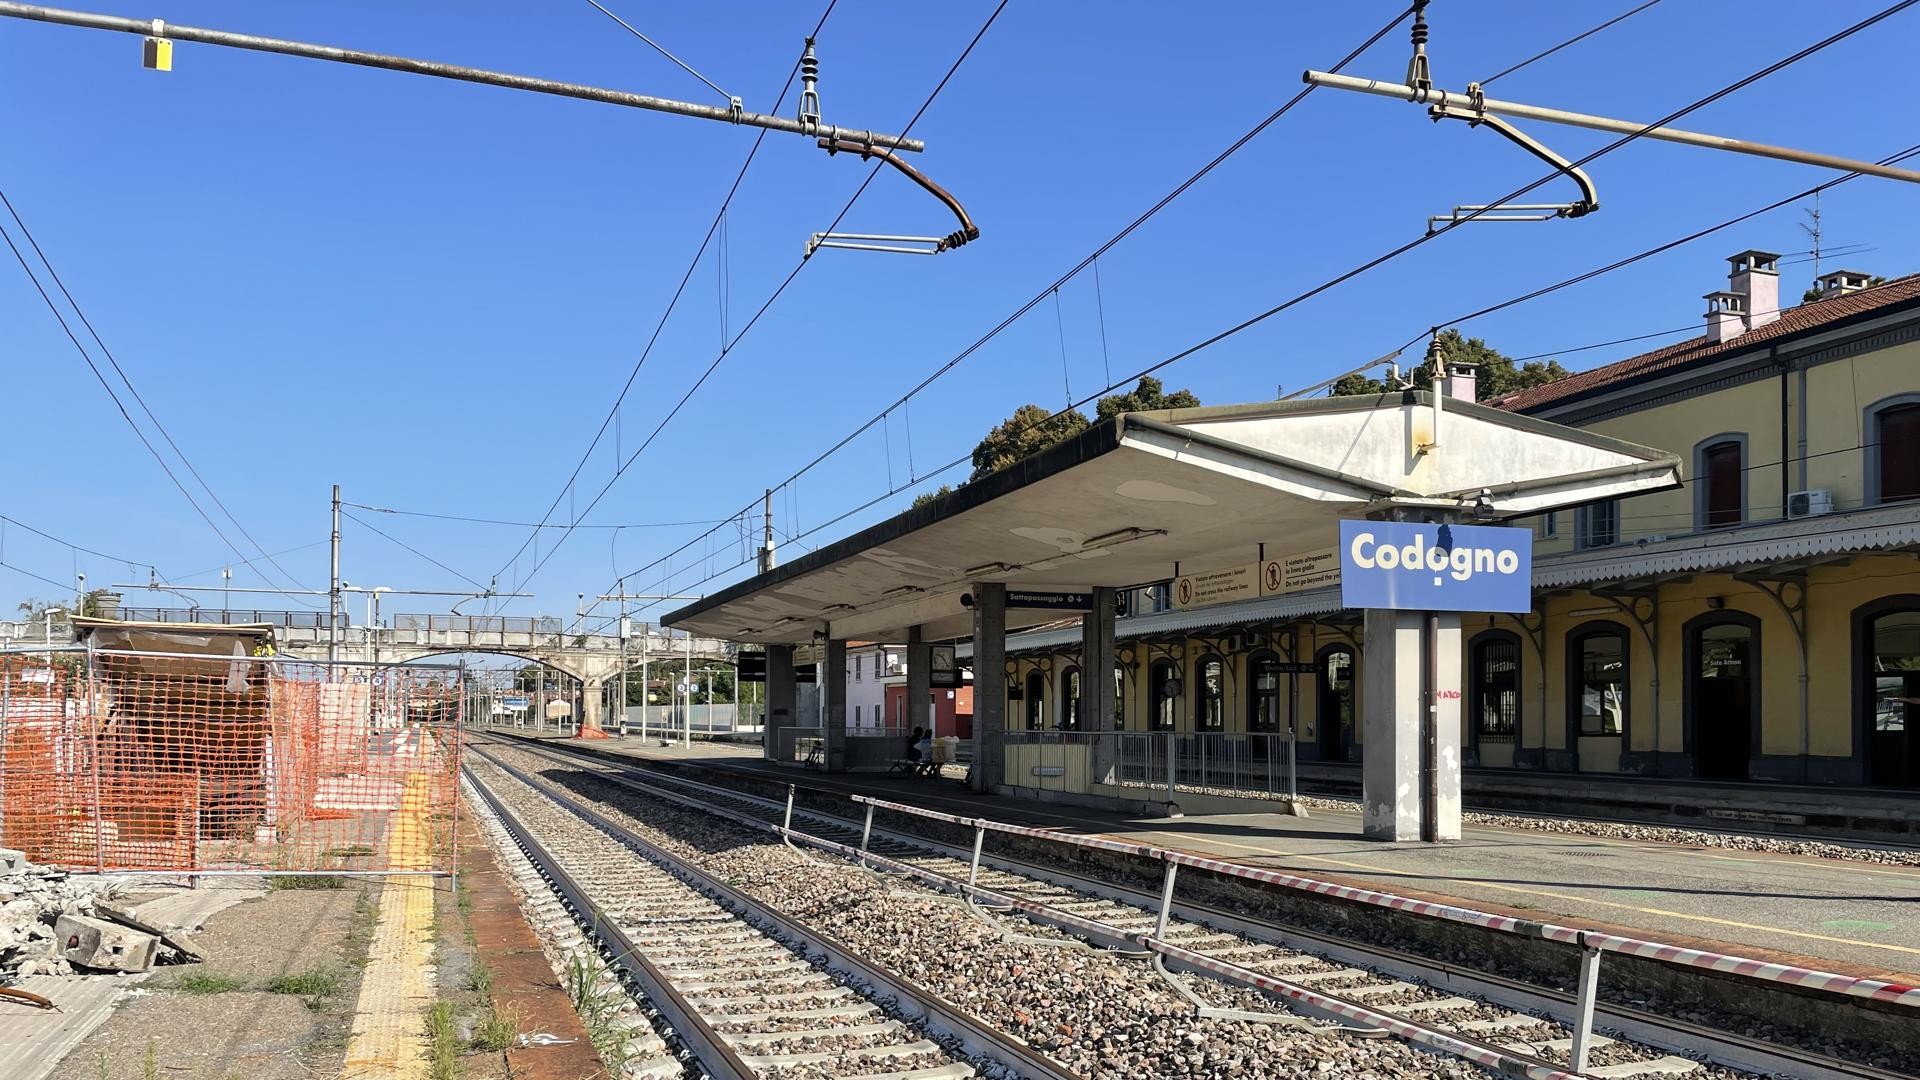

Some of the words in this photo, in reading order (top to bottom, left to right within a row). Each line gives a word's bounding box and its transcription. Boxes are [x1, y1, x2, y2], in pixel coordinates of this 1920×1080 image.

[1304, 553, 1333, 563] oltrepassare
[1351, 533, 1519, 581] Codogno
[1290, 566, 1302, 574] linea
[1300, 579, 1307, 587] go
[1306, 575, 1325, 585] beyond
[1009, 593, 1064, 603] Sottopassaggio
